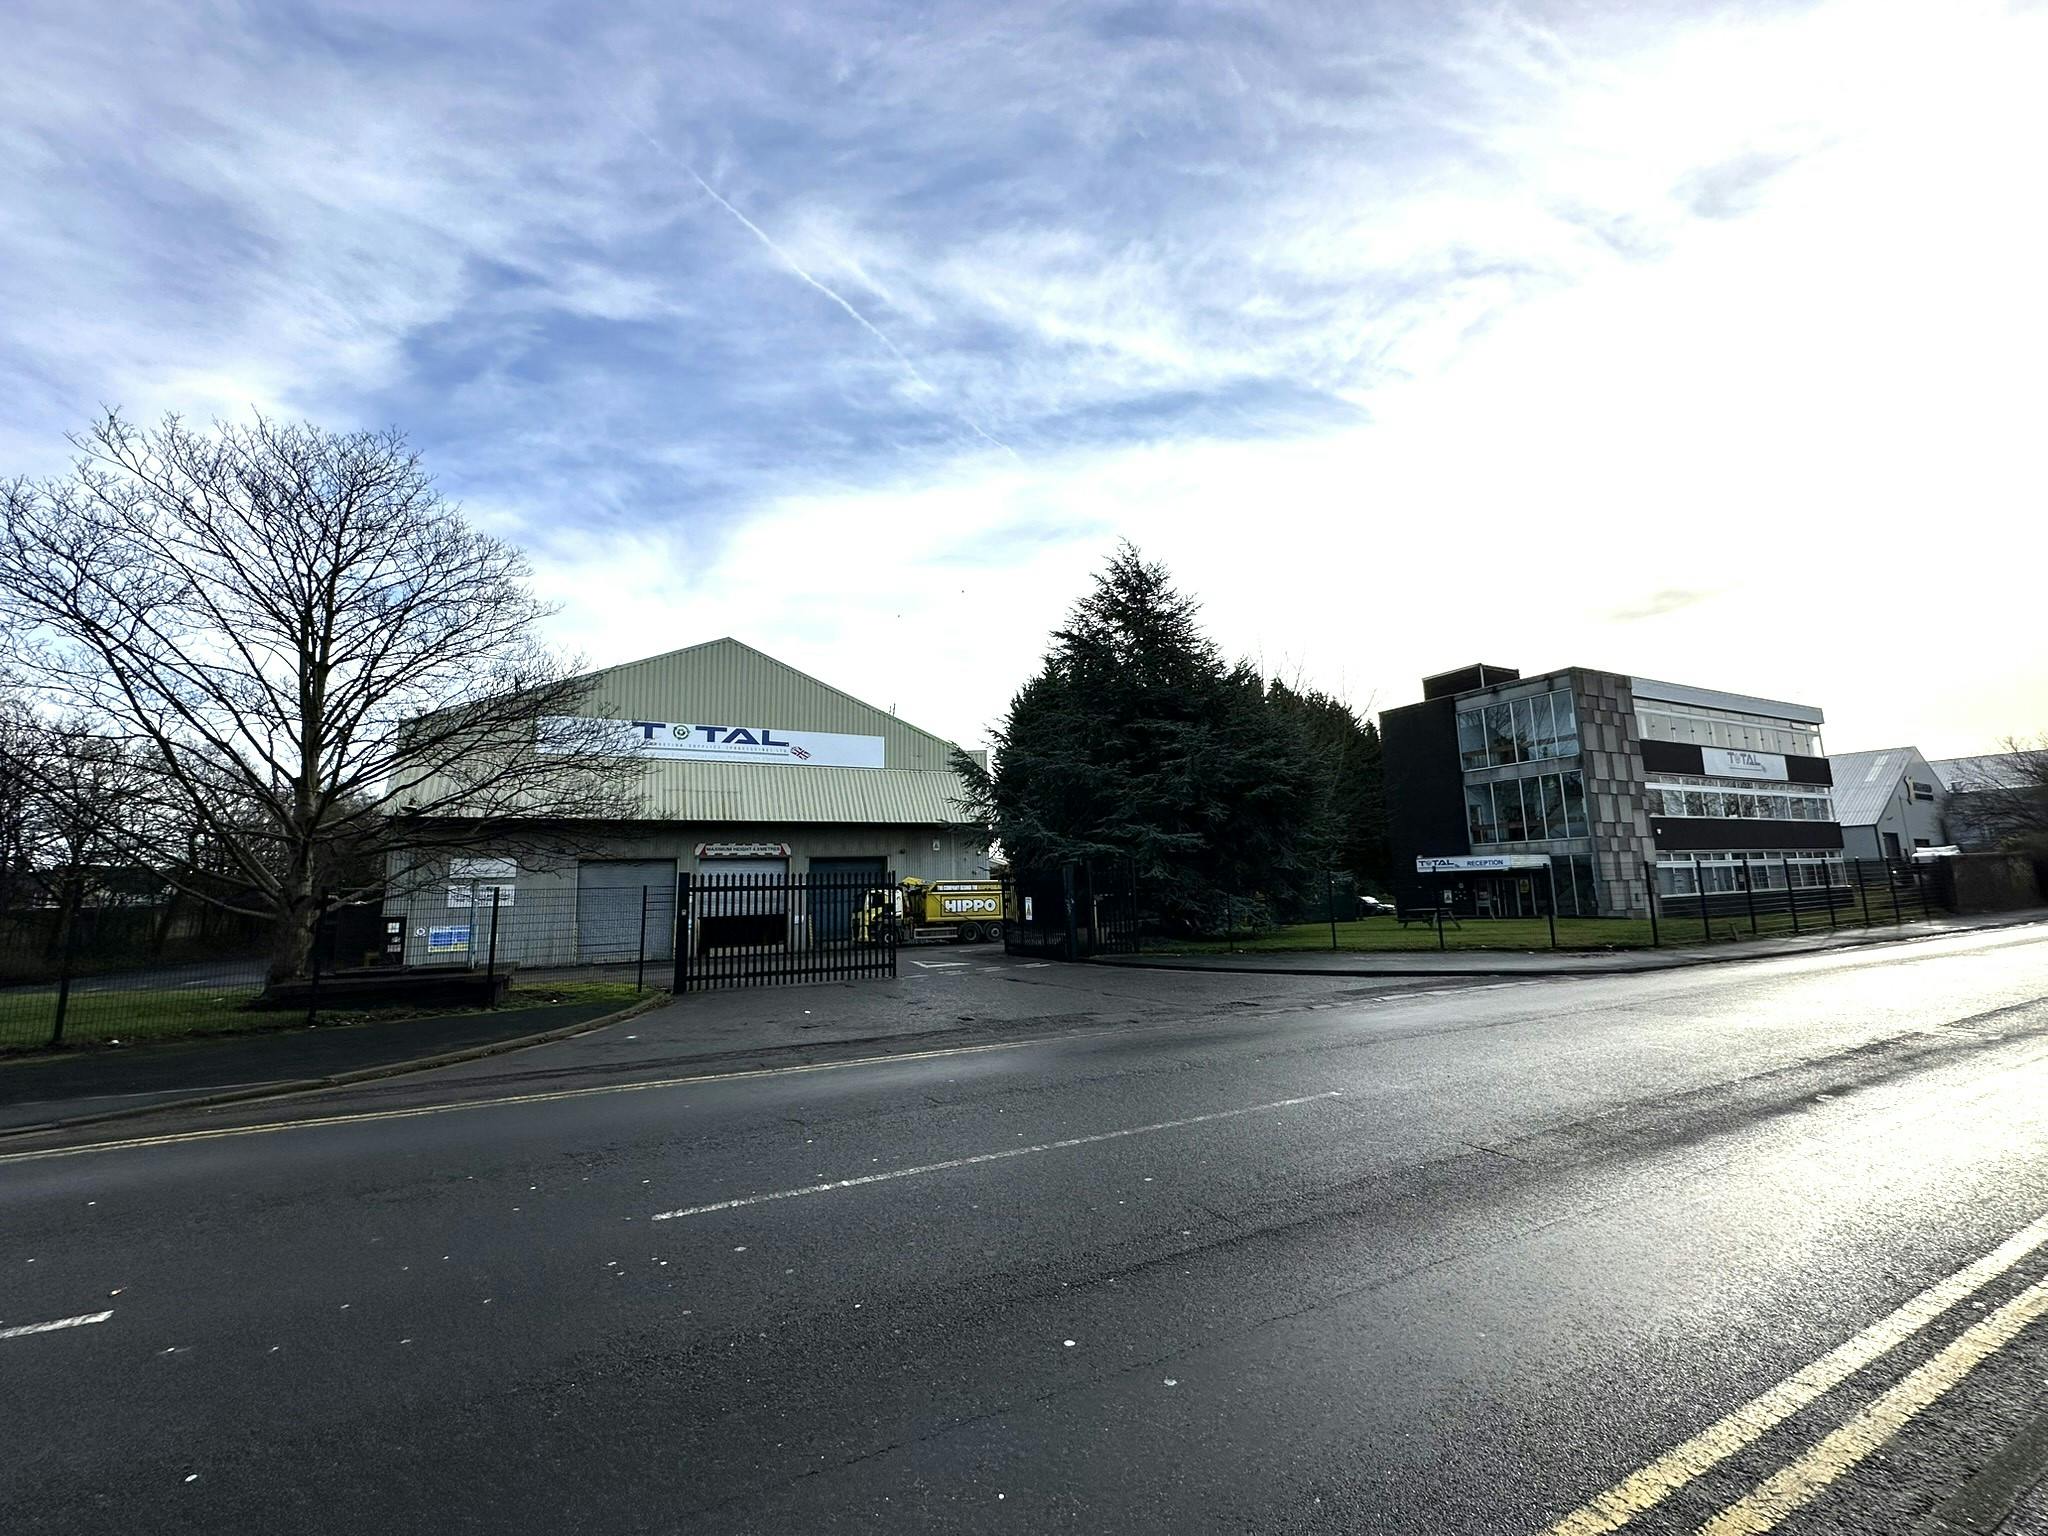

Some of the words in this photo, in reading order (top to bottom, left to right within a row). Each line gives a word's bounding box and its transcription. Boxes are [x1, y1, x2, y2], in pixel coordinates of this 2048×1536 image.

[632, 722, 789, 747] TOTAL
[1727, 752, 1761, 766] TOTAL
[944, 898, 997, 912] HIPPO
